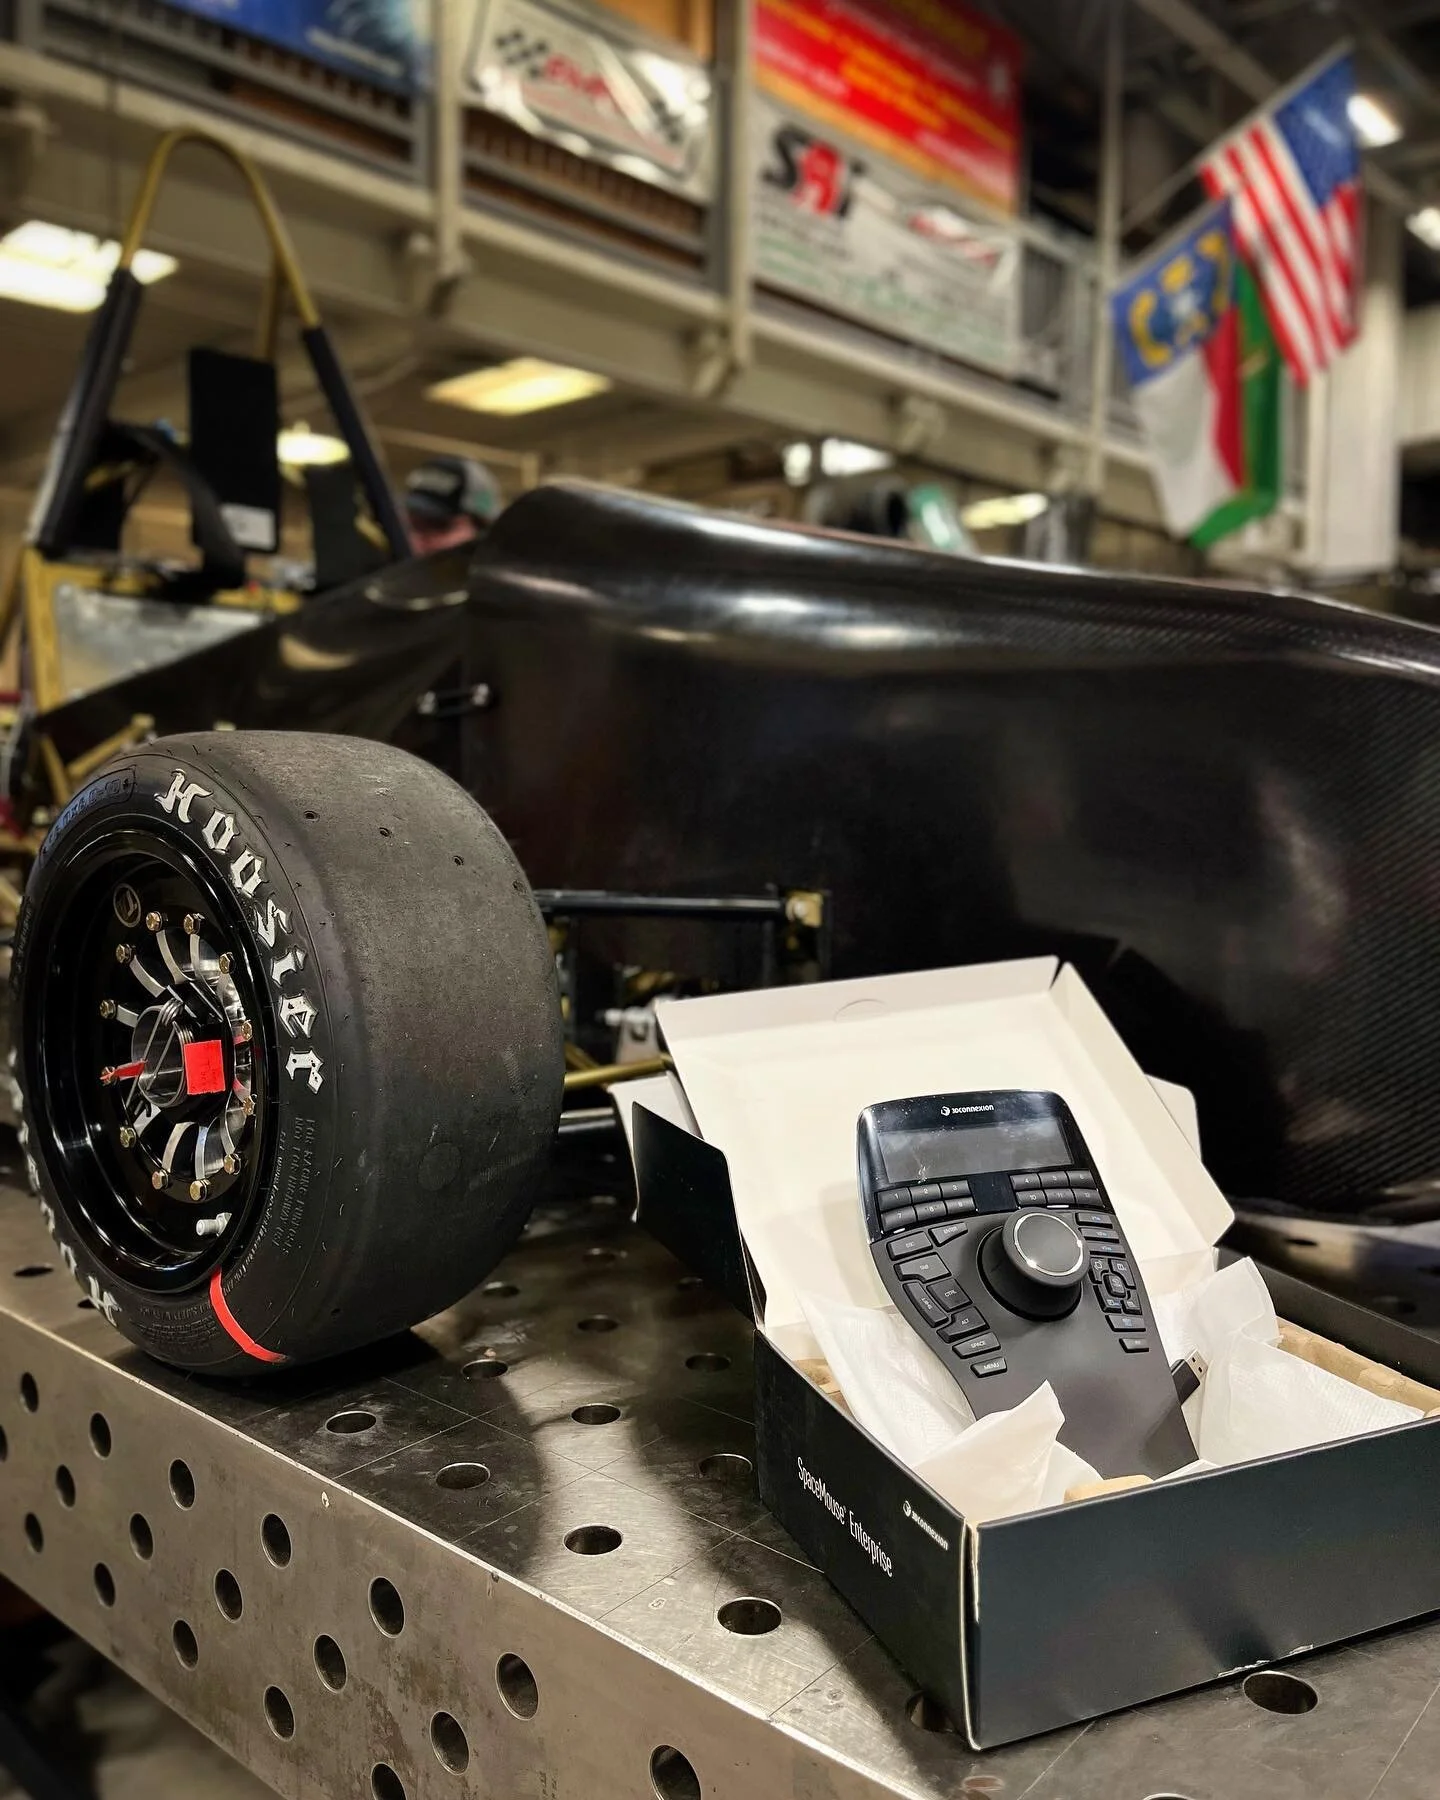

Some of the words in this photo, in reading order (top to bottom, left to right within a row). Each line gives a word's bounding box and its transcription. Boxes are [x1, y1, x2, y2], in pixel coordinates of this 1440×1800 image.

[154, 769, 325, 1095] Hoosier
[944, 1289, 957, 1298] CTRL
[970, 1340, 986, 1348] SPACE
[983, 1362, 1000, 1370] MENU
[848, 1510, 893, 1577] Enterprise
